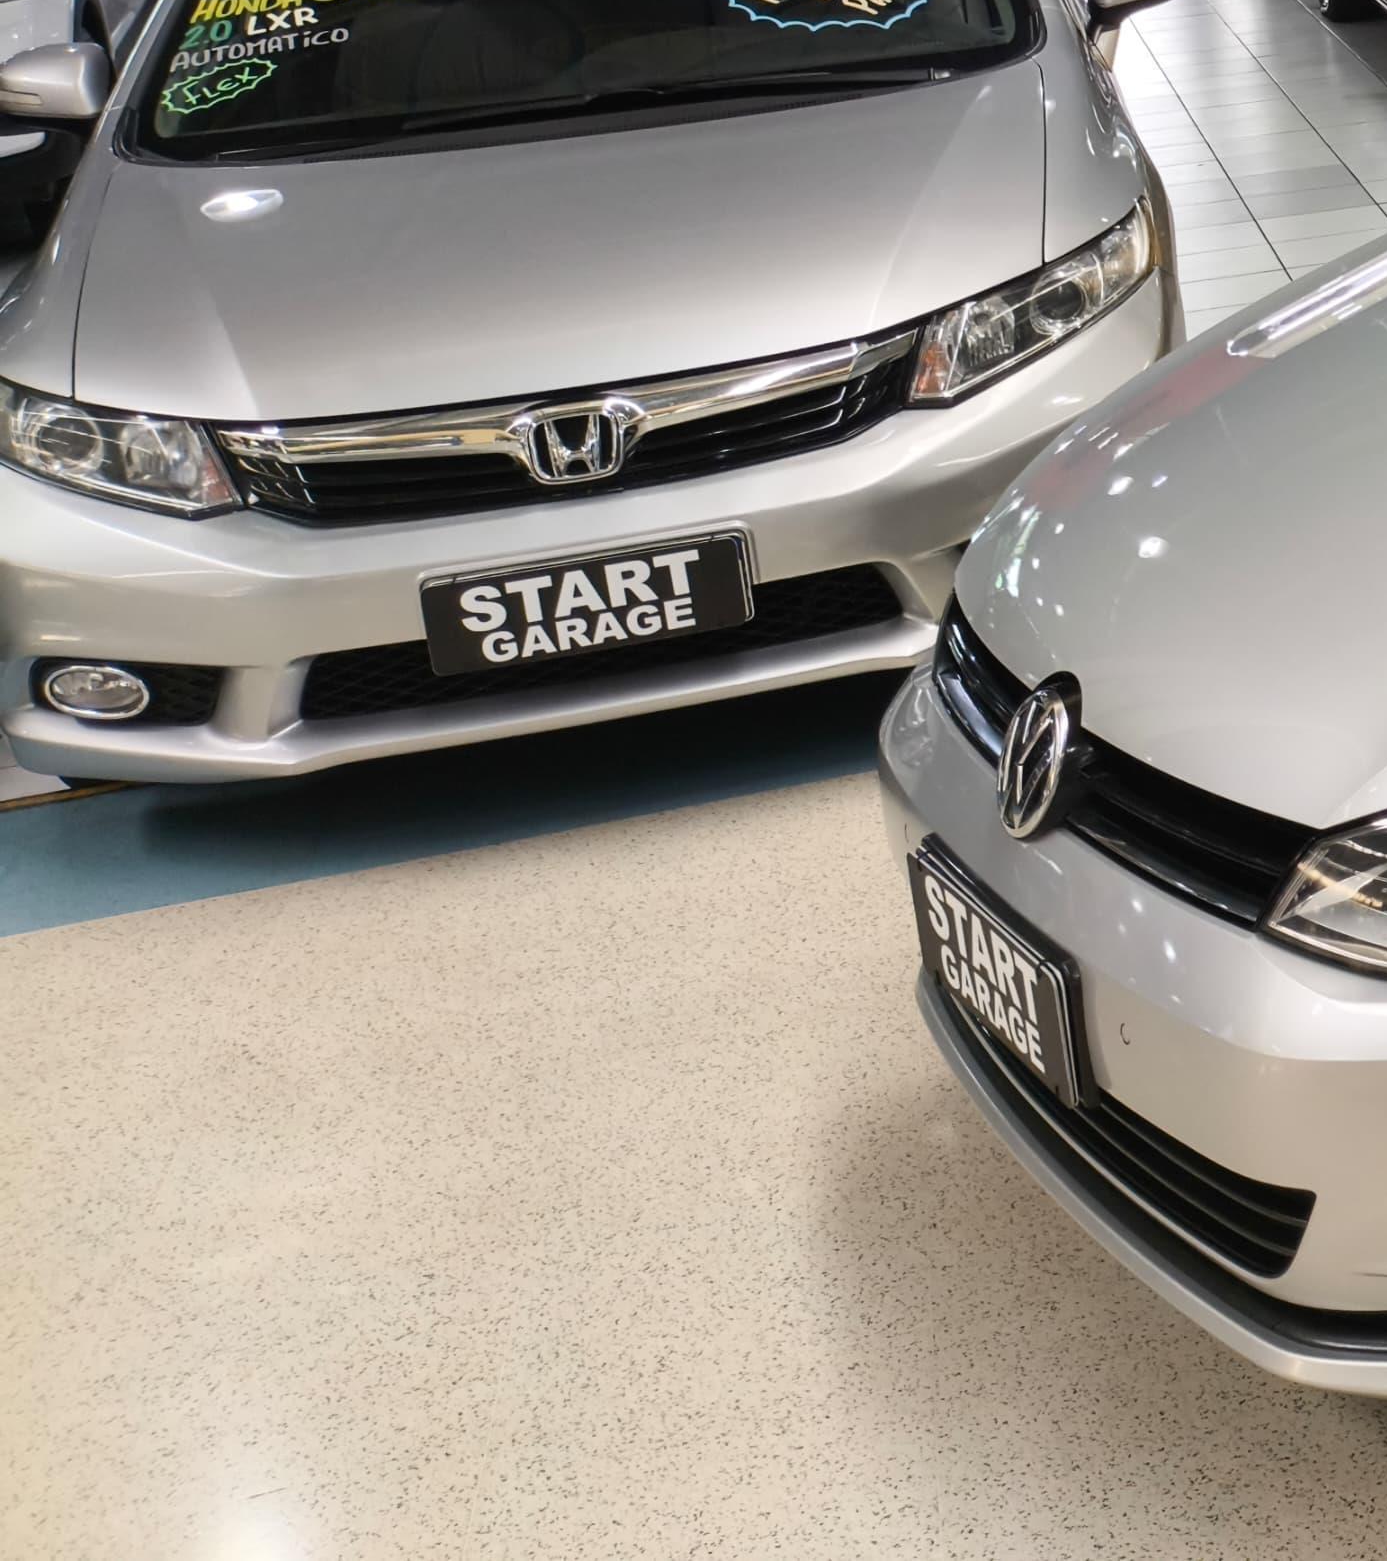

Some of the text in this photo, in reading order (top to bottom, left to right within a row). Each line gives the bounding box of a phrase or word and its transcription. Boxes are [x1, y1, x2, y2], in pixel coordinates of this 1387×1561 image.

[178, 6, 320, 50] 2.0 LXR
[459, 549, 700, 632] START
[482, 597, 697, 664] GARAGE
[924, 874, 1040, 1026] START
[940, 942, 1045, 1076] GARAGE
